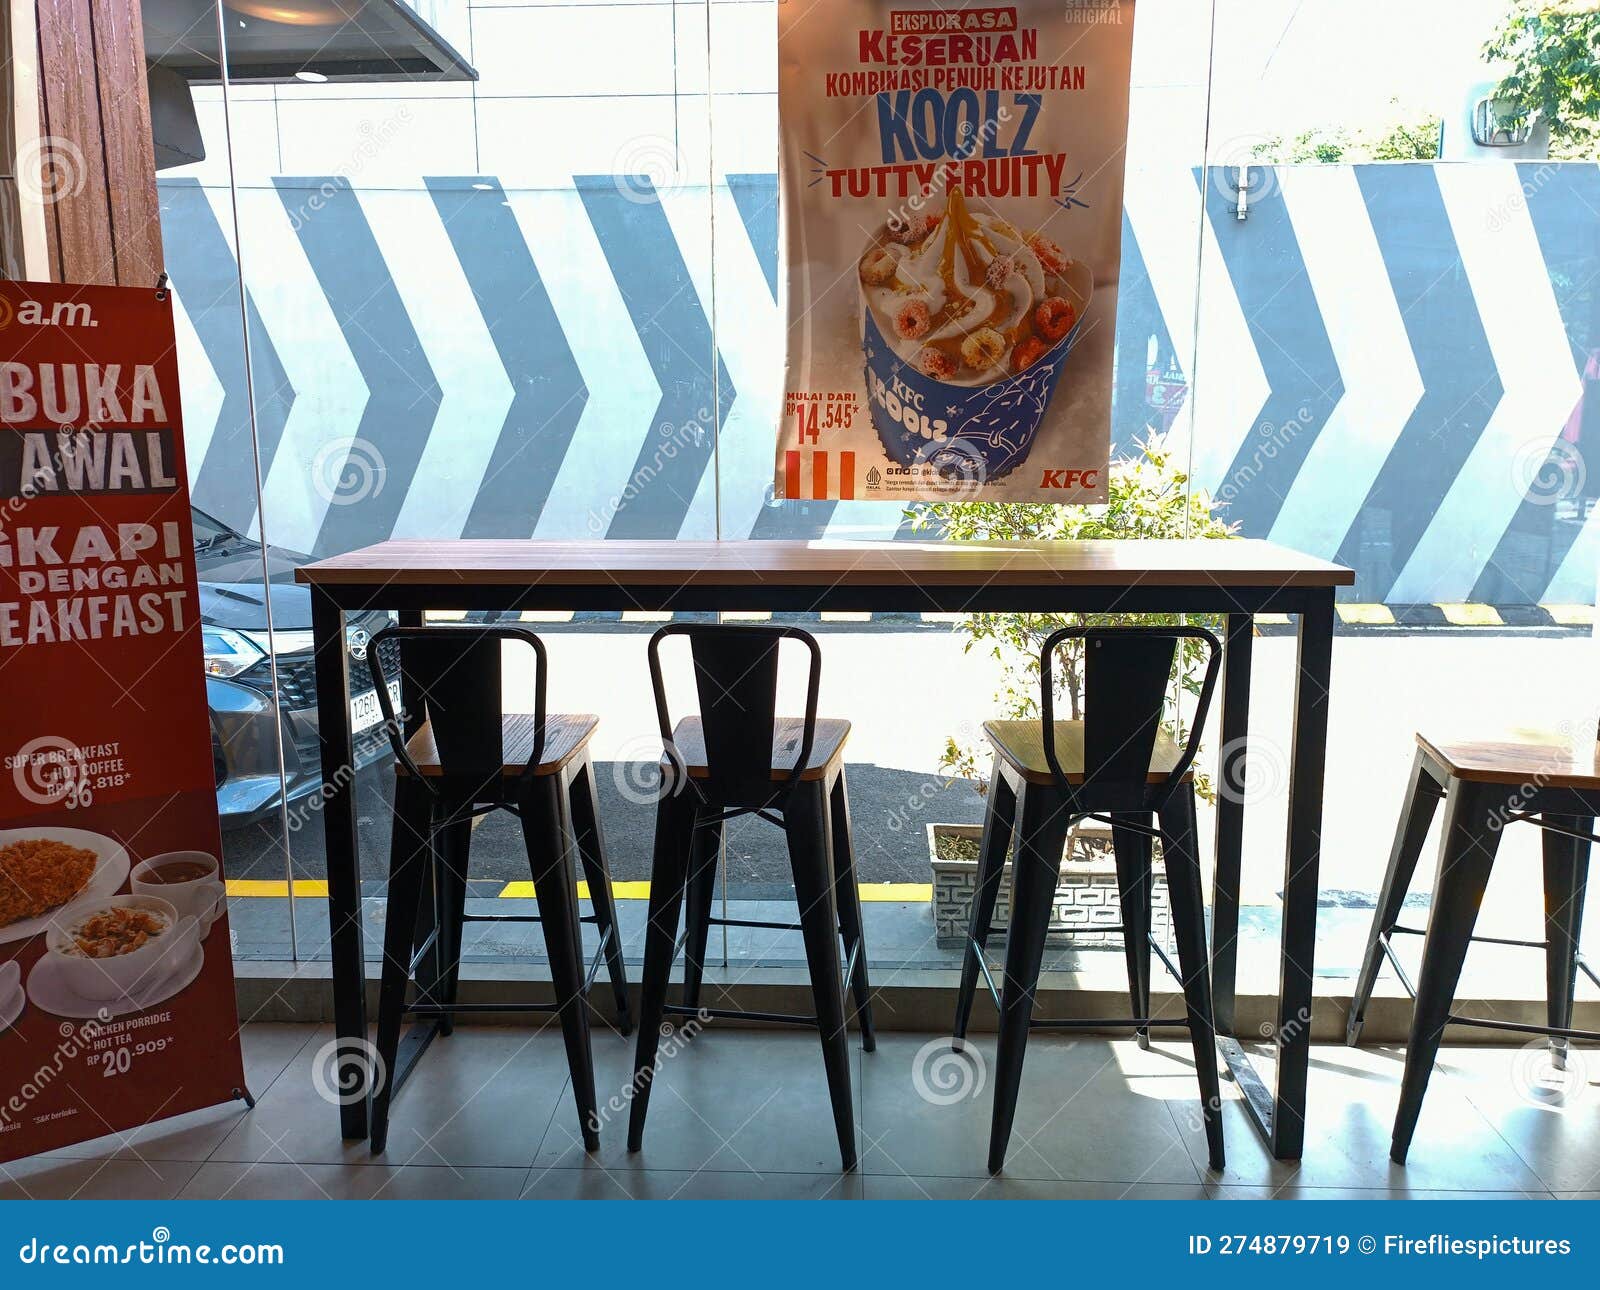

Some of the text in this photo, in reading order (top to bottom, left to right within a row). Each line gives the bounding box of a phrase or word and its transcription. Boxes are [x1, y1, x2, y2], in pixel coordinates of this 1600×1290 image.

[893, 11, 1014, 31] EKSPLORASA
[1065, 8, 1123, 25] ORIGINAL
[858, 28, 1038, 66] KESERUAN
[826, 65, 1086, 97] KOMBINASI PENUH KEJUTAN
[876, 87, 1043, 164] KOOLZ
[826, 153, 1067, 198] TUTTY FRUITY
[17, 300, 99, 327] a.m.
[0, 361, 168, 424] BUKA
[786, 392, 857, 402] MULAI DARI
[868, 366, 948, 443] KOOLZ
[892, 375, 925, 411] KFC
[786, 402, 796, 417] RP
[20, 431, 177, 491] AWAL
[1039, 469, 1098, 489] KFC
[18, 562, 185, 594] DENGAN
[0, 590, 188, 647] EAKFAST
[4, 742, 120, 769] SUPER BREAKFAST
[51, 764, 78, 781] HOT
[81, 758, 125, 776] COFFEE
[85, 1012, 172, 1039] CHICKEN PORRIDGE
[93, 1037, 113, 1051] HOT
[114, 1033, 133, 1046] TEA
[87, 1054, 100, 1066] RP
